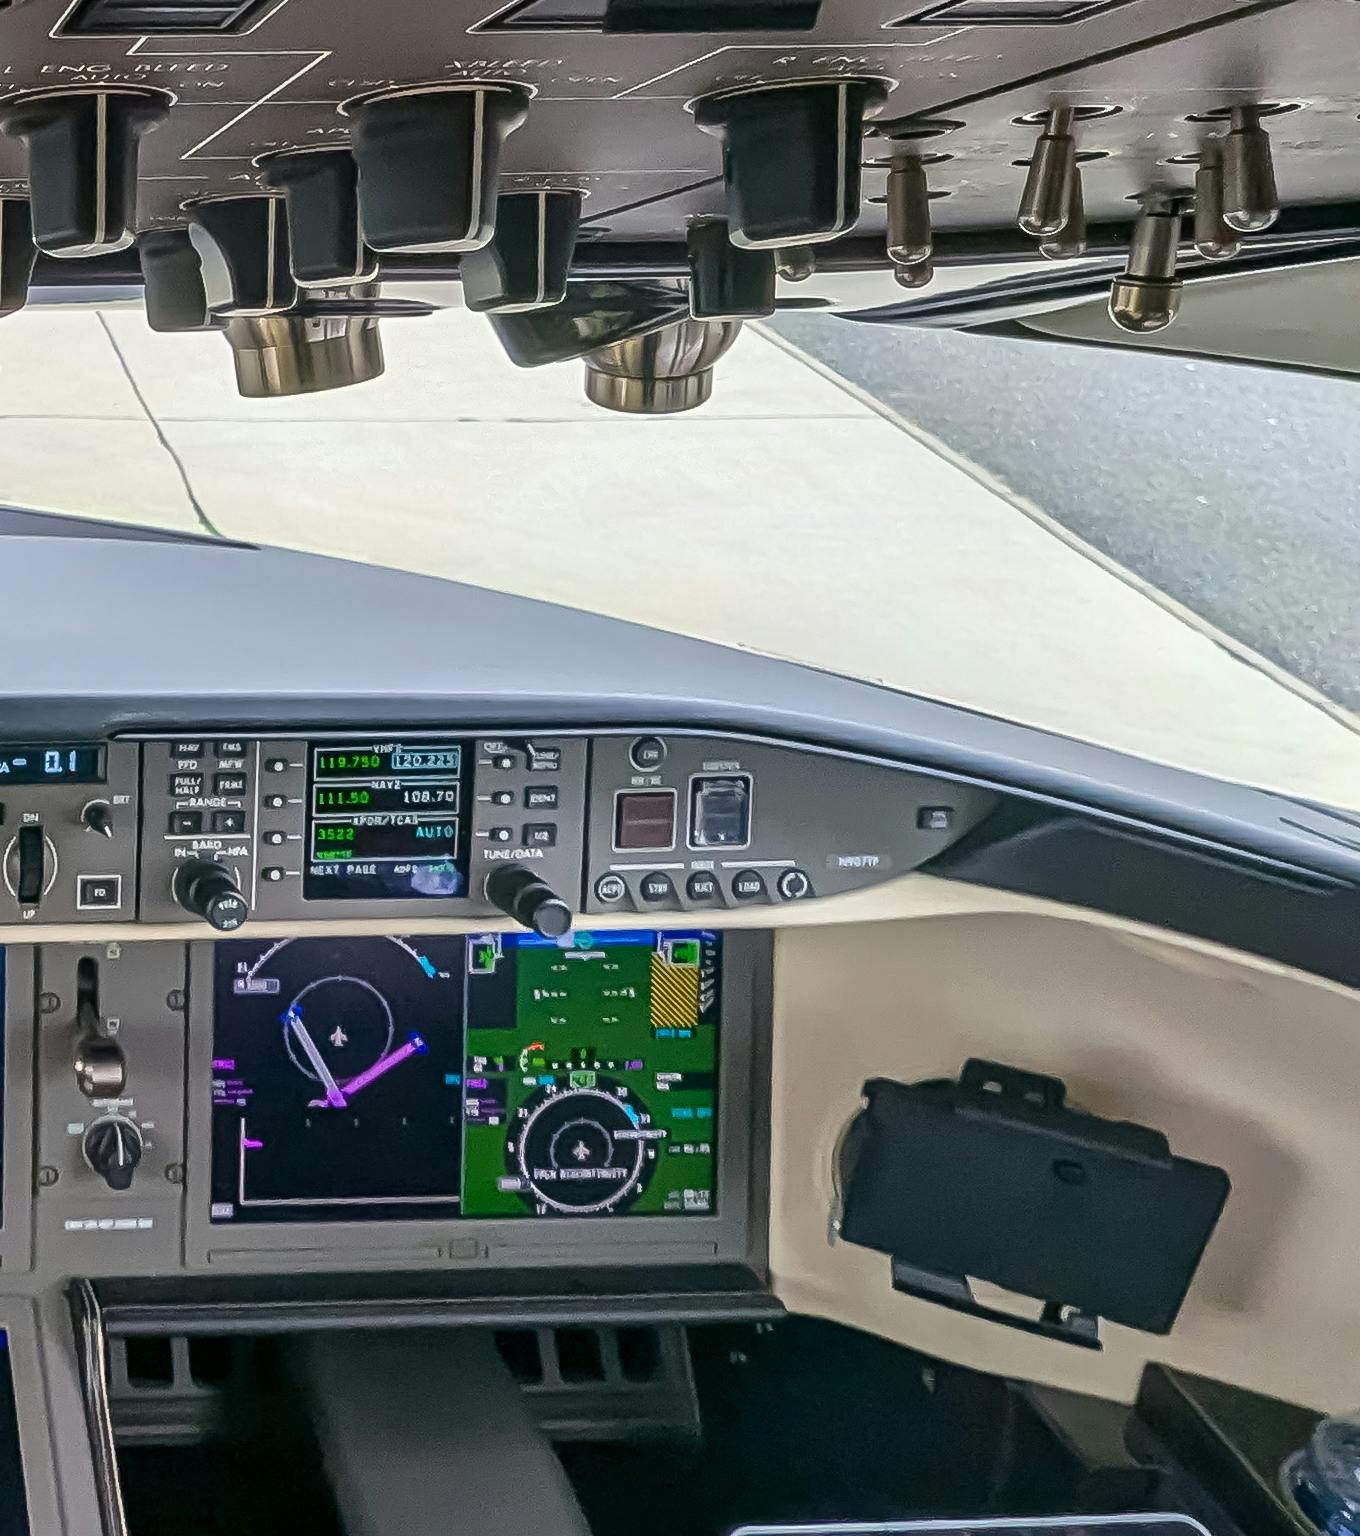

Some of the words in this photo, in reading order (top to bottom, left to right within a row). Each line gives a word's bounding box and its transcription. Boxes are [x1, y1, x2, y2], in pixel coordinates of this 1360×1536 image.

[40, 63, 112, 74] ENG
[44, 749, 78, 774] 0.1
[112, 794, 131, 805] BRT
[188, 797, 227, 808] RANGE
[318, 791, 370, 805] 111.50
[403, 790, 455, 804] 108.70
[22, 812, 39, 823] DN
[317, 827, 355, 841] 3522
[415, 825, 454, 839] AUTO
[483, 848, 544, 860] TUNE/DATA
[345, 863, 377, 875] PAGE
[22, 909, 36, 920] UP
